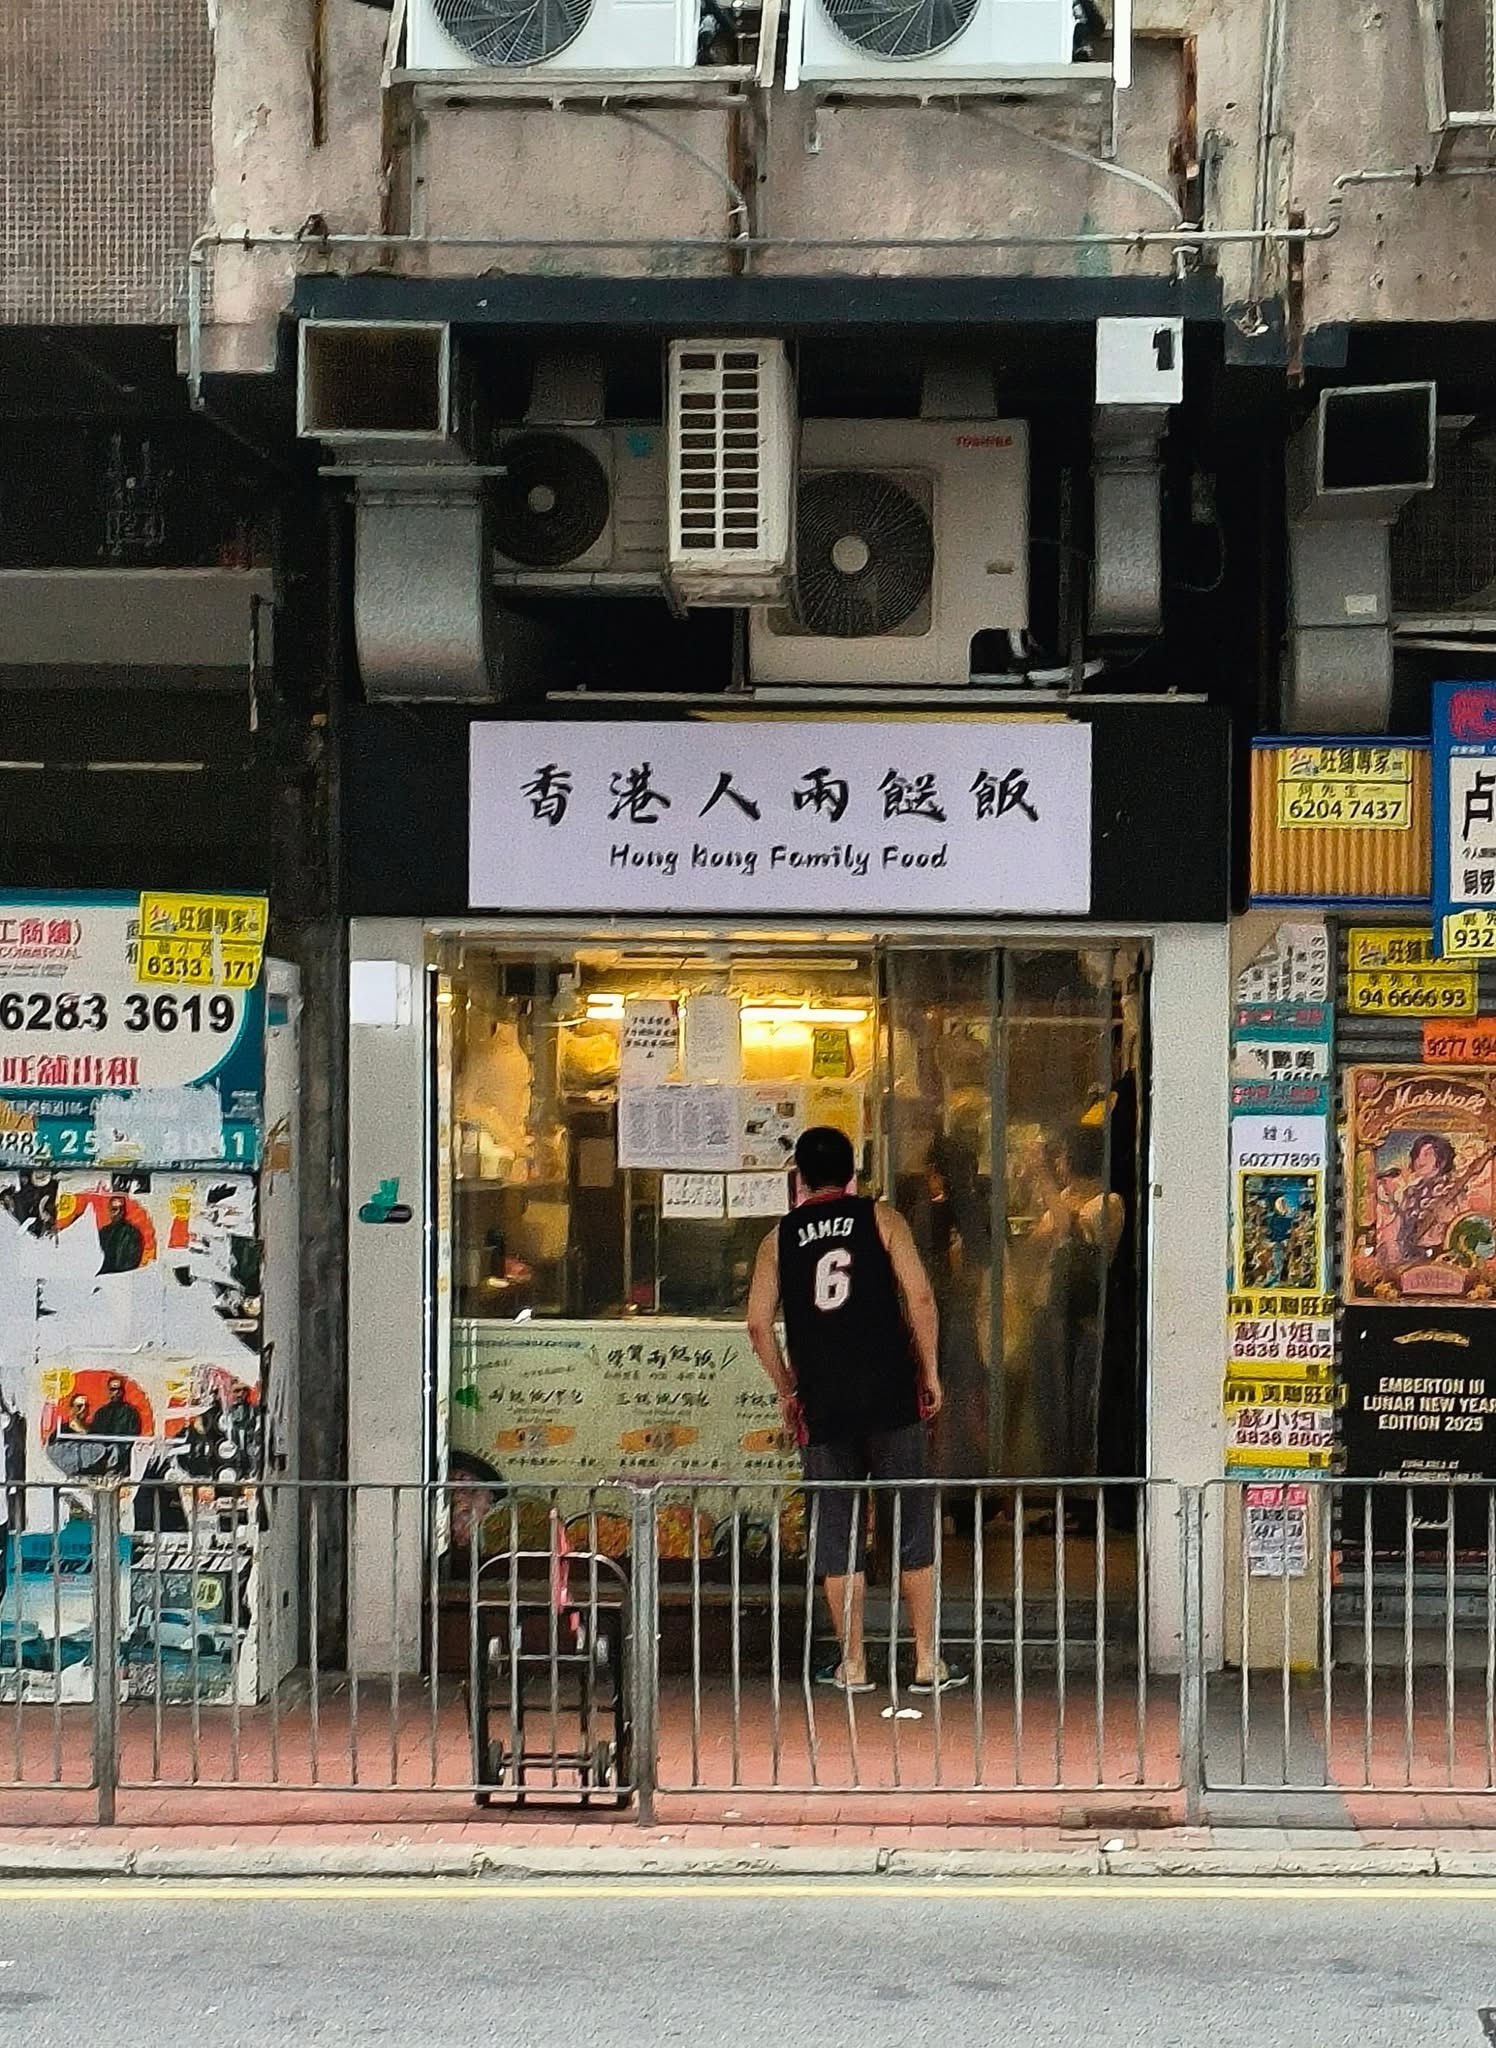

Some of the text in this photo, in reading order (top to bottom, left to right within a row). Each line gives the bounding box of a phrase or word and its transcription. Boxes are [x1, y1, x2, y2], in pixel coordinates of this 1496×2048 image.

[520, 762, 1039, 825] 香港人兩餸飯
[1290, 799, 1402, 819] 6204 7437
[610, 843, 679, 876] Hong
[770, 844, 870, 876] Family
[882, 842, 948, 870] Food
[147, 957, 254, 980] 6333 171
[0, 993, 234, 1033] 6283 3619
[798, 1217, 854, 1247] JAMES
[814, 1248, 852, 1311] 6
[1378, 1377, 1464, 1395] EMBERTON
[1363, 1395, 1415, 1412] LUNAR
[1420, 1397, 1455, 1413] NEW
[1377, 1414, 1484, 1432] EDITION 2025
